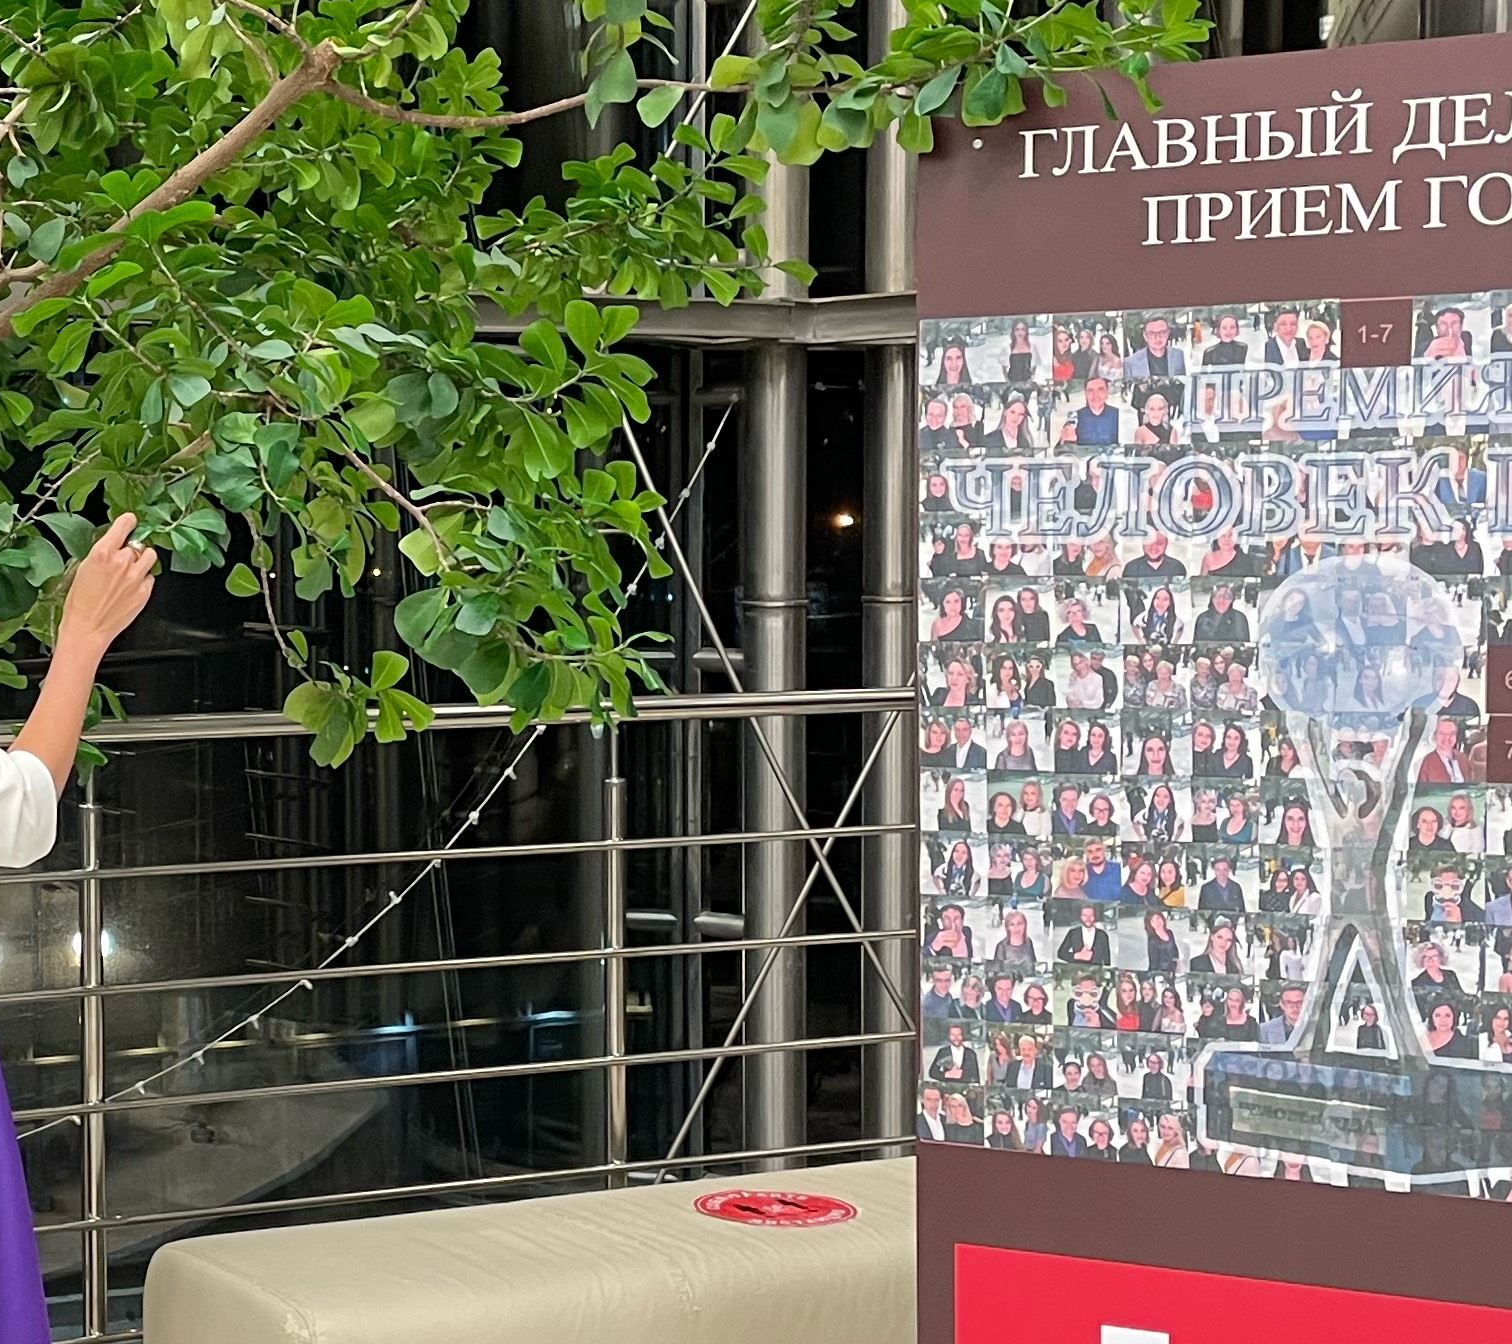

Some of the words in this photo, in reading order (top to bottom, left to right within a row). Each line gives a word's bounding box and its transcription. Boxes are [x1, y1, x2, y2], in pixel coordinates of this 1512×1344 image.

[1017, 88, 1374, 179] ГЛАВНЫЙ
[1392, 89, 1512, 163] ДЕ
[1141, 179, 1403, 246] ПРИЕМ
[1357, 323, 1394, 345] 1-7
[1186, 357, 1512, 426] ПРЕМИЯ
[945, 453, 1455, 538] ЧЕЛОВЕК
